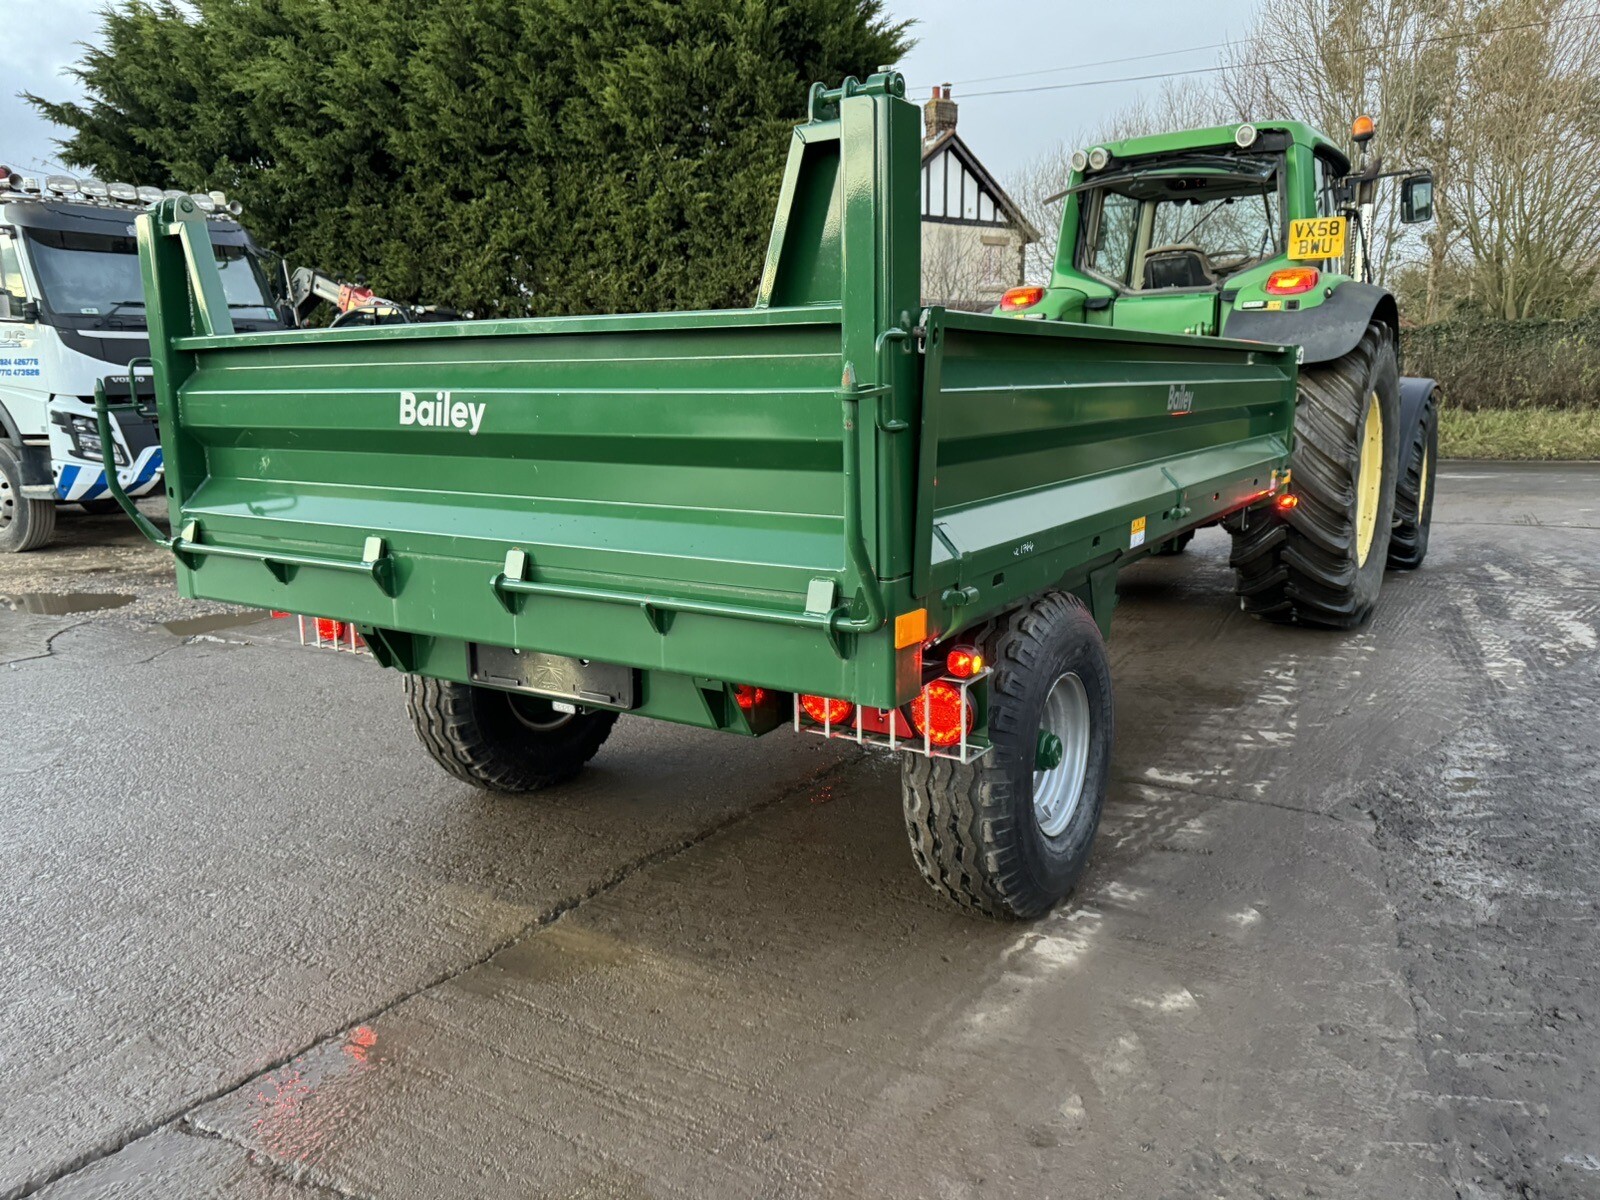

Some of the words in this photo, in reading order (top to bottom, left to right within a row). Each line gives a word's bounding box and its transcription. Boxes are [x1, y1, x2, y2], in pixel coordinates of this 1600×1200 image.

[1295, 221, 1340, 238] VX58
[1298, 238, 1333, 255] BWU
[1167, 384, 1194, 412] Bailey
[399, 390, 487, 436] Bailey
